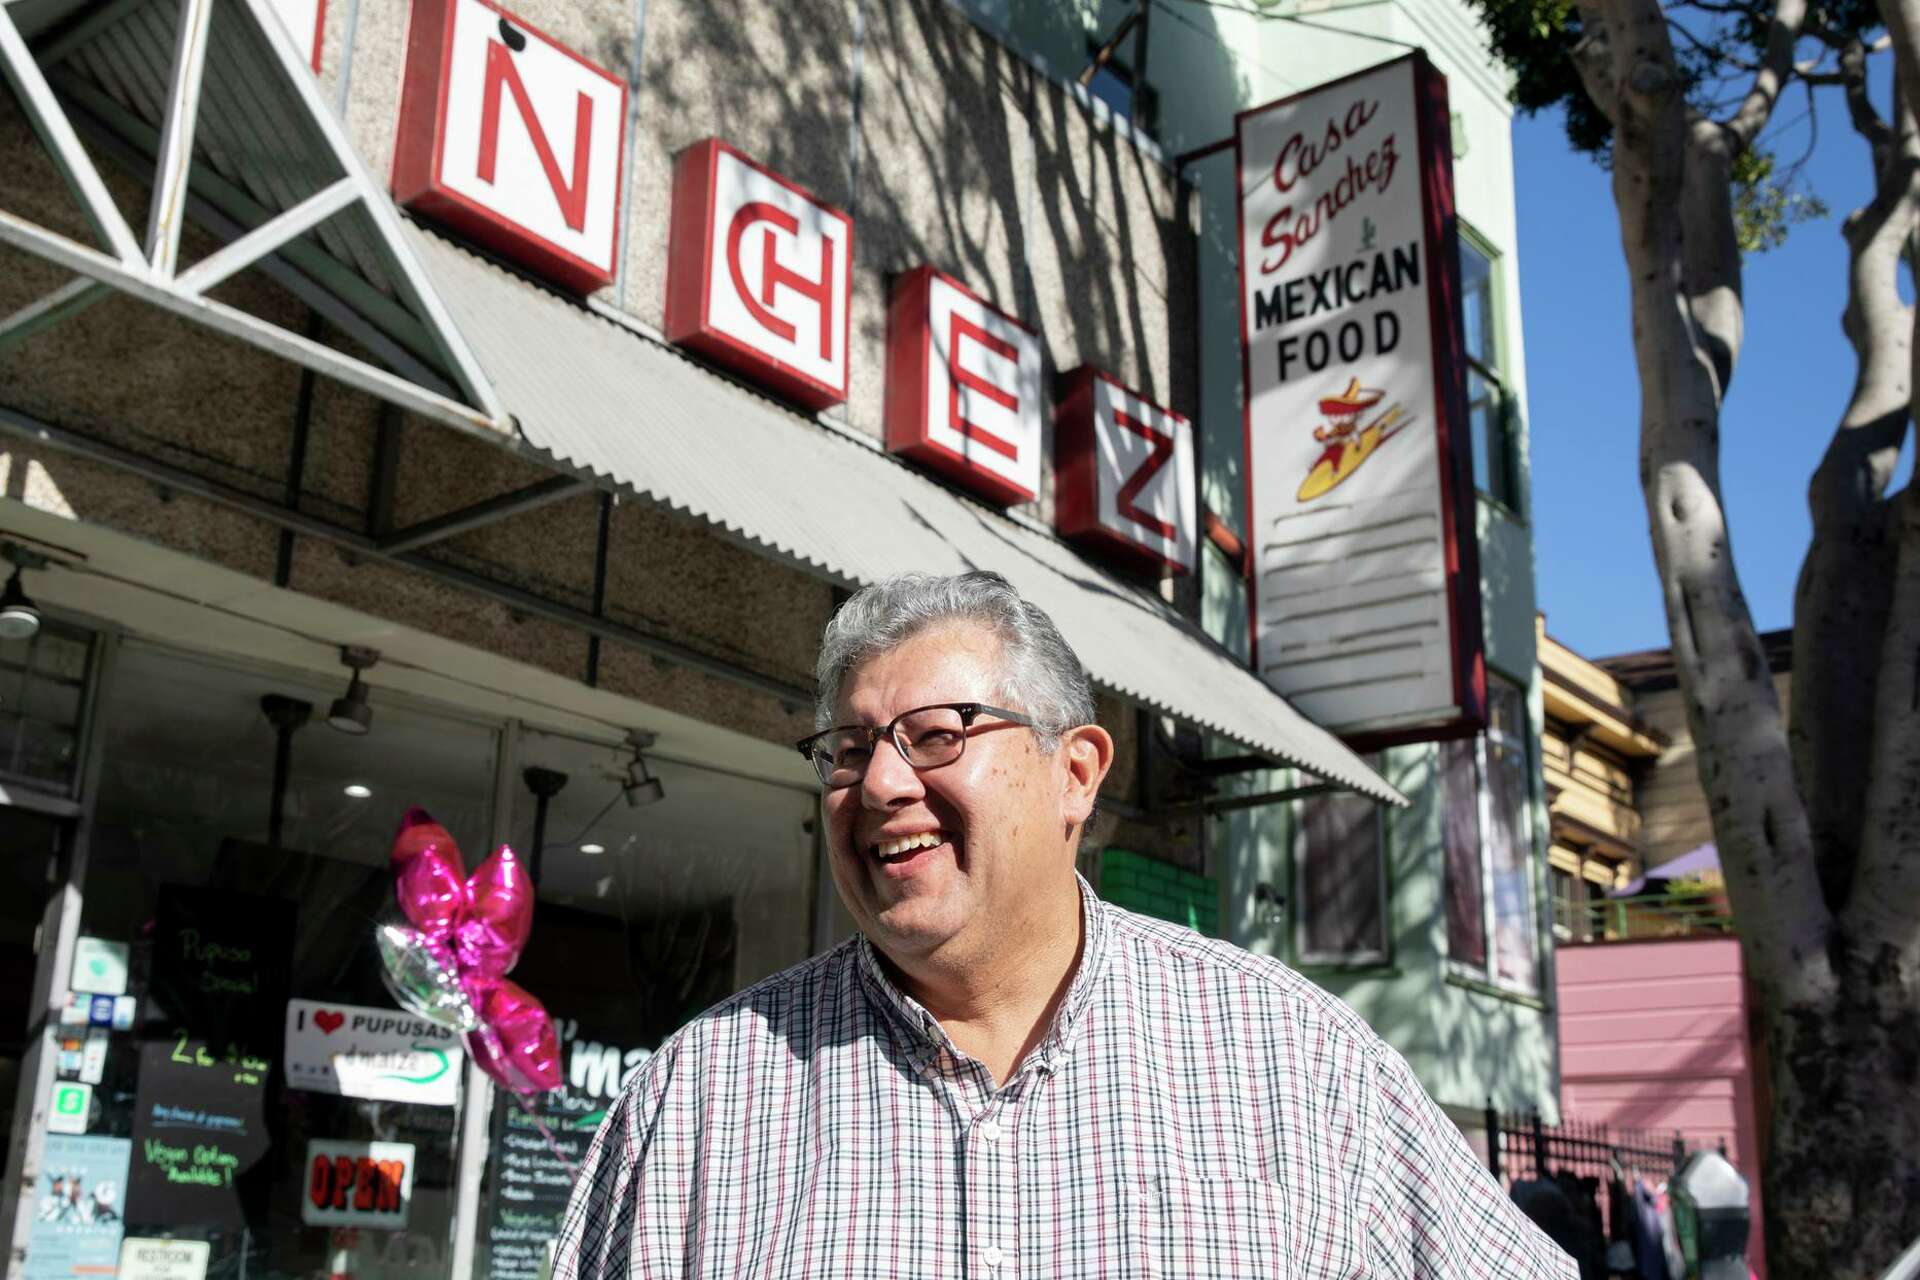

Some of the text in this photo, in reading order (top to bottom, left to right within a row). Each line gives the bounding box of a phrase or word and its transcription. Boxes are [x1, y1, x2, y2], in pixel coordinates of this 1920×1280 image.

[1274, 99, 1378, 193] Casa
[1260, 132, 1399, 275] Sanchez
[1254, 241, 1421, 331] MEXICAN
[1277, 309, 1400, 383] FOOD
[297, 1008, 453, 1040] I PUPUSAS
[144, 1136, 189, 1171] Vegan
[309, 1153, 405, 1214] OPEN
